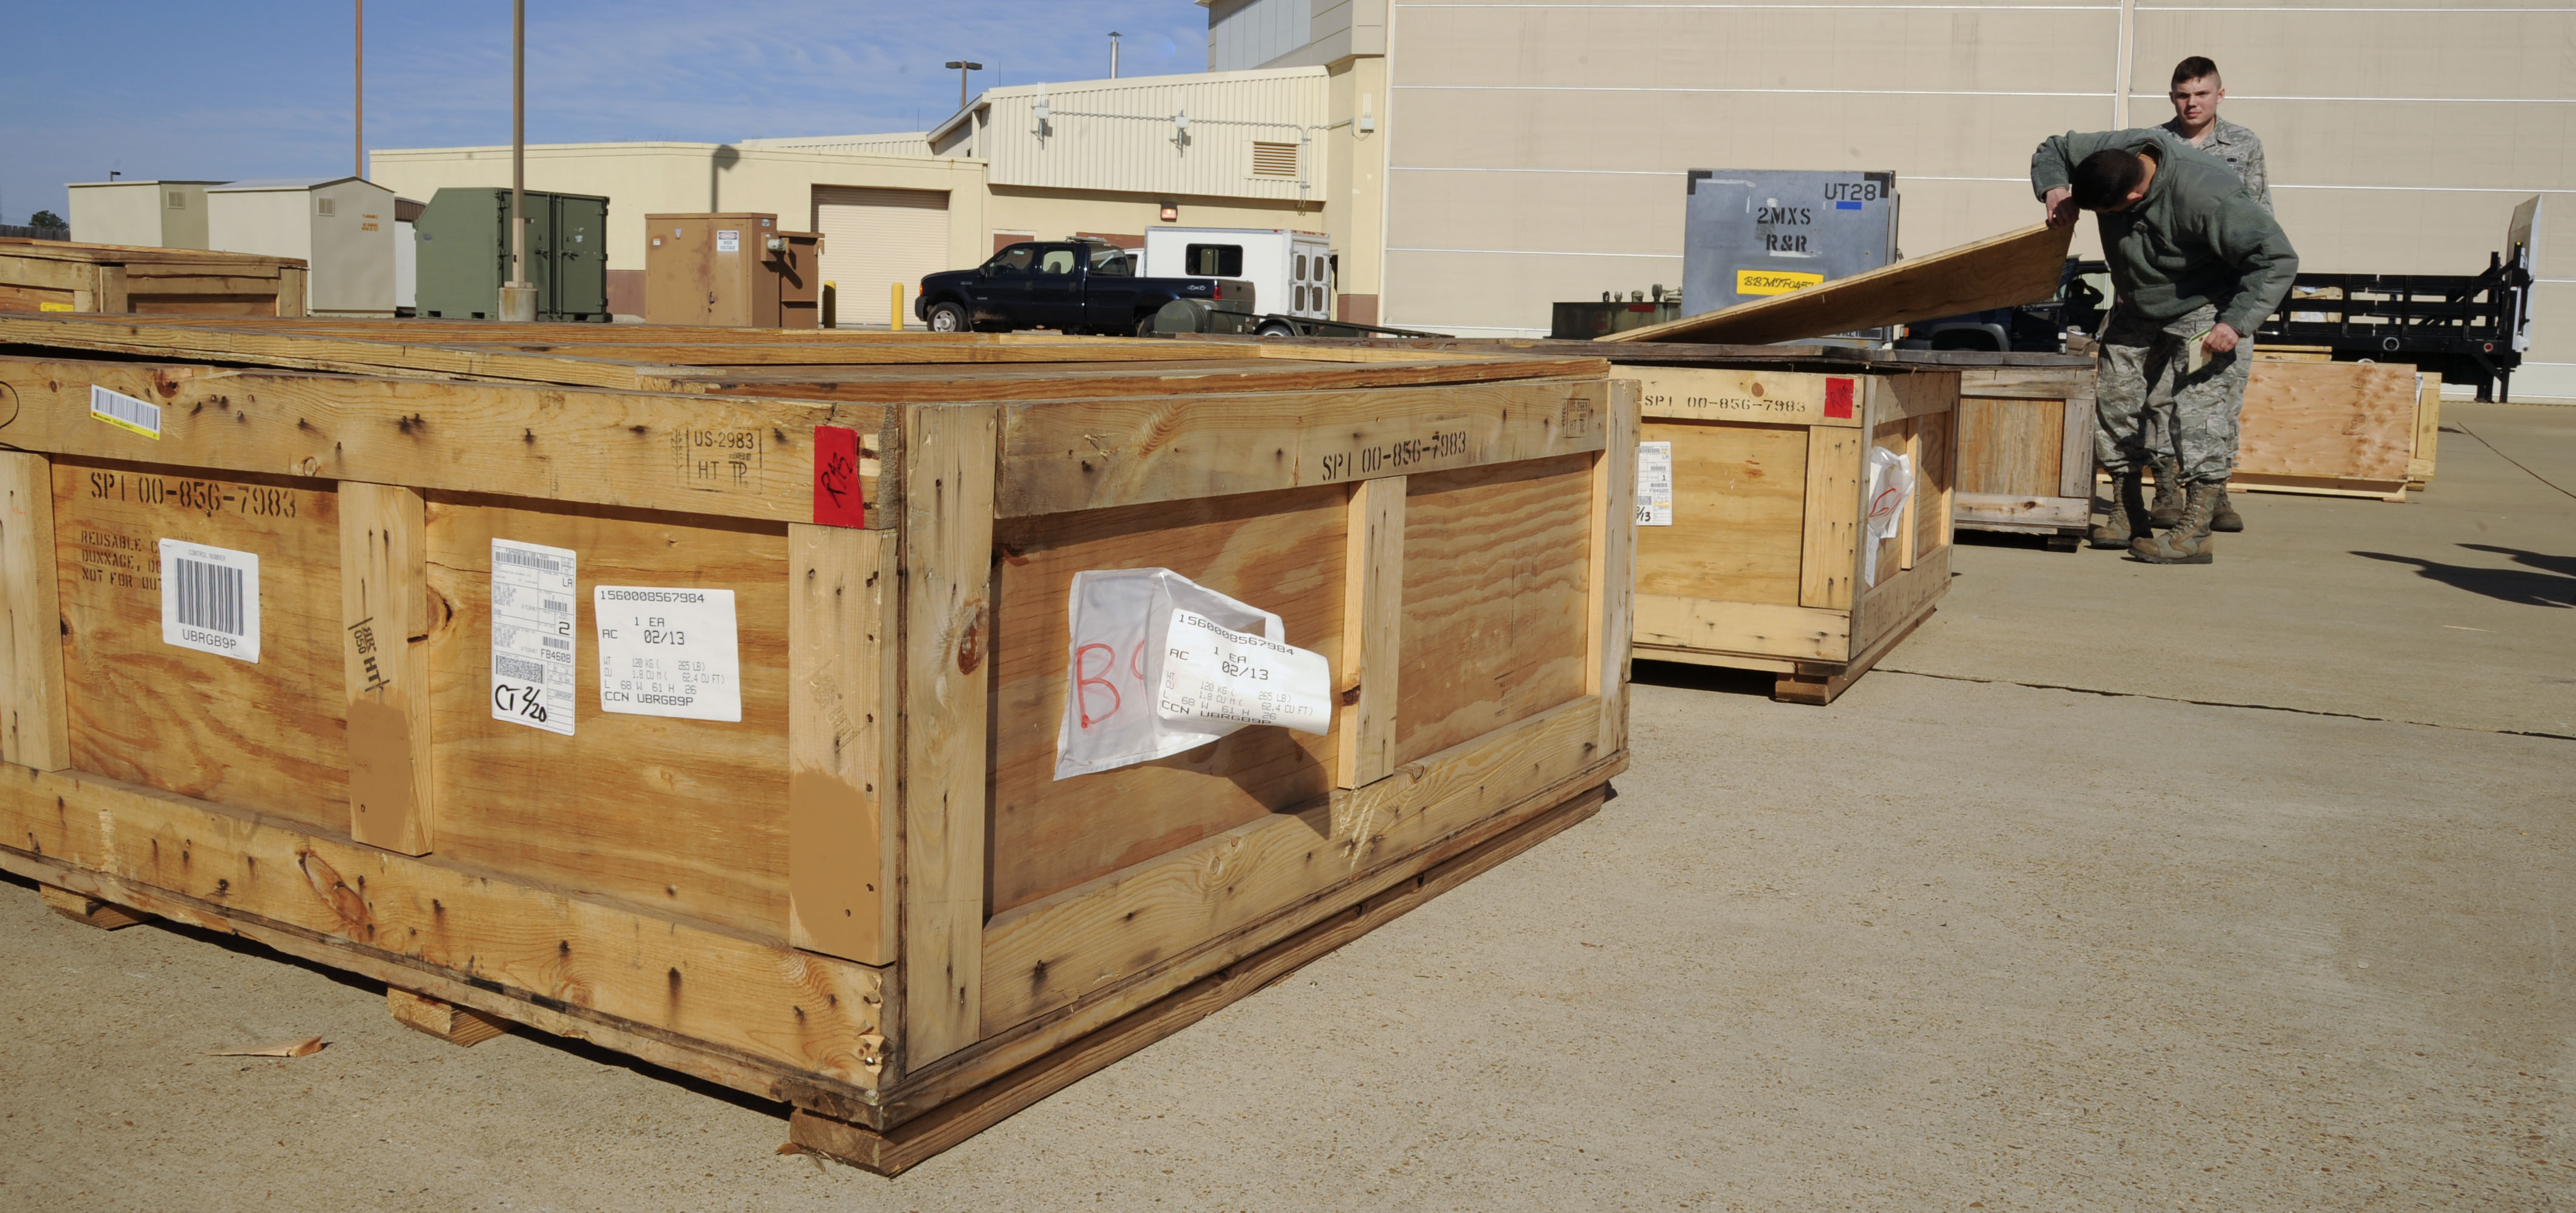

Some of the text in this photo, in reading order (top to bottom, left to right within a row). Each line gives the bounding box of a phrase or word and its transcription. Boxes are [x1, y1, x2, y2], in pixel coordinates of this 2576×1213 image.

[1824, 182, 1876, 201] UT28
[1757, 206, 1812, 226] 2MXS
[1766, 234, 1807, 252] R&R
[1687, 396, 1806, 412] 00-856-7983
[694, 430, 754, 449] US-2983
[1362, 430, 1466, 473] 00-856-7983
[698, 461, 720, 479] HT
[139, 477, 296, 518] 00-856-7983
[81, 530, 142, 552] REUSABLE
[189, 549, 226, 561] CONTROL NUMBER
[82, 567, 103, 582] NOT
[111, 572, 133, 588] FOR
[562, 577, 573, 588] LA
[600, 590, 705, 603] 1560008567984
[559, 621, 570, 636] 2
[649, 617, 665, 627] EA
[182, 628, 237, 649] UBRGB9P
[602, 629, 685, 645] AC 02/13
[1178, 614, 1294, 655] 1560008567984
[1169, 648, 1268, 680] AC 02/13
[1229, 653, 1246, 663] EA
[632, 669, 643, 679] 1.8
[605, 680, 610, 689] L
[620, 680, 632, 690] 68
[652, 683, 662, 692] 61
[668, 684, 674, 693] H
[685, 685, 697, 694] 26
[605, 691, 694, 706] CCN UBRGB9P
[1162, 700, 1191, 715] CCN
[1198, 691, 1212, 701] 1.8
[1261, 702, 1281, 712] 62.4
[1181, 696, 1195, 706] 68
[1221, 705, 1234, 714] 61
[1262, 711, 1277, 721] 26
